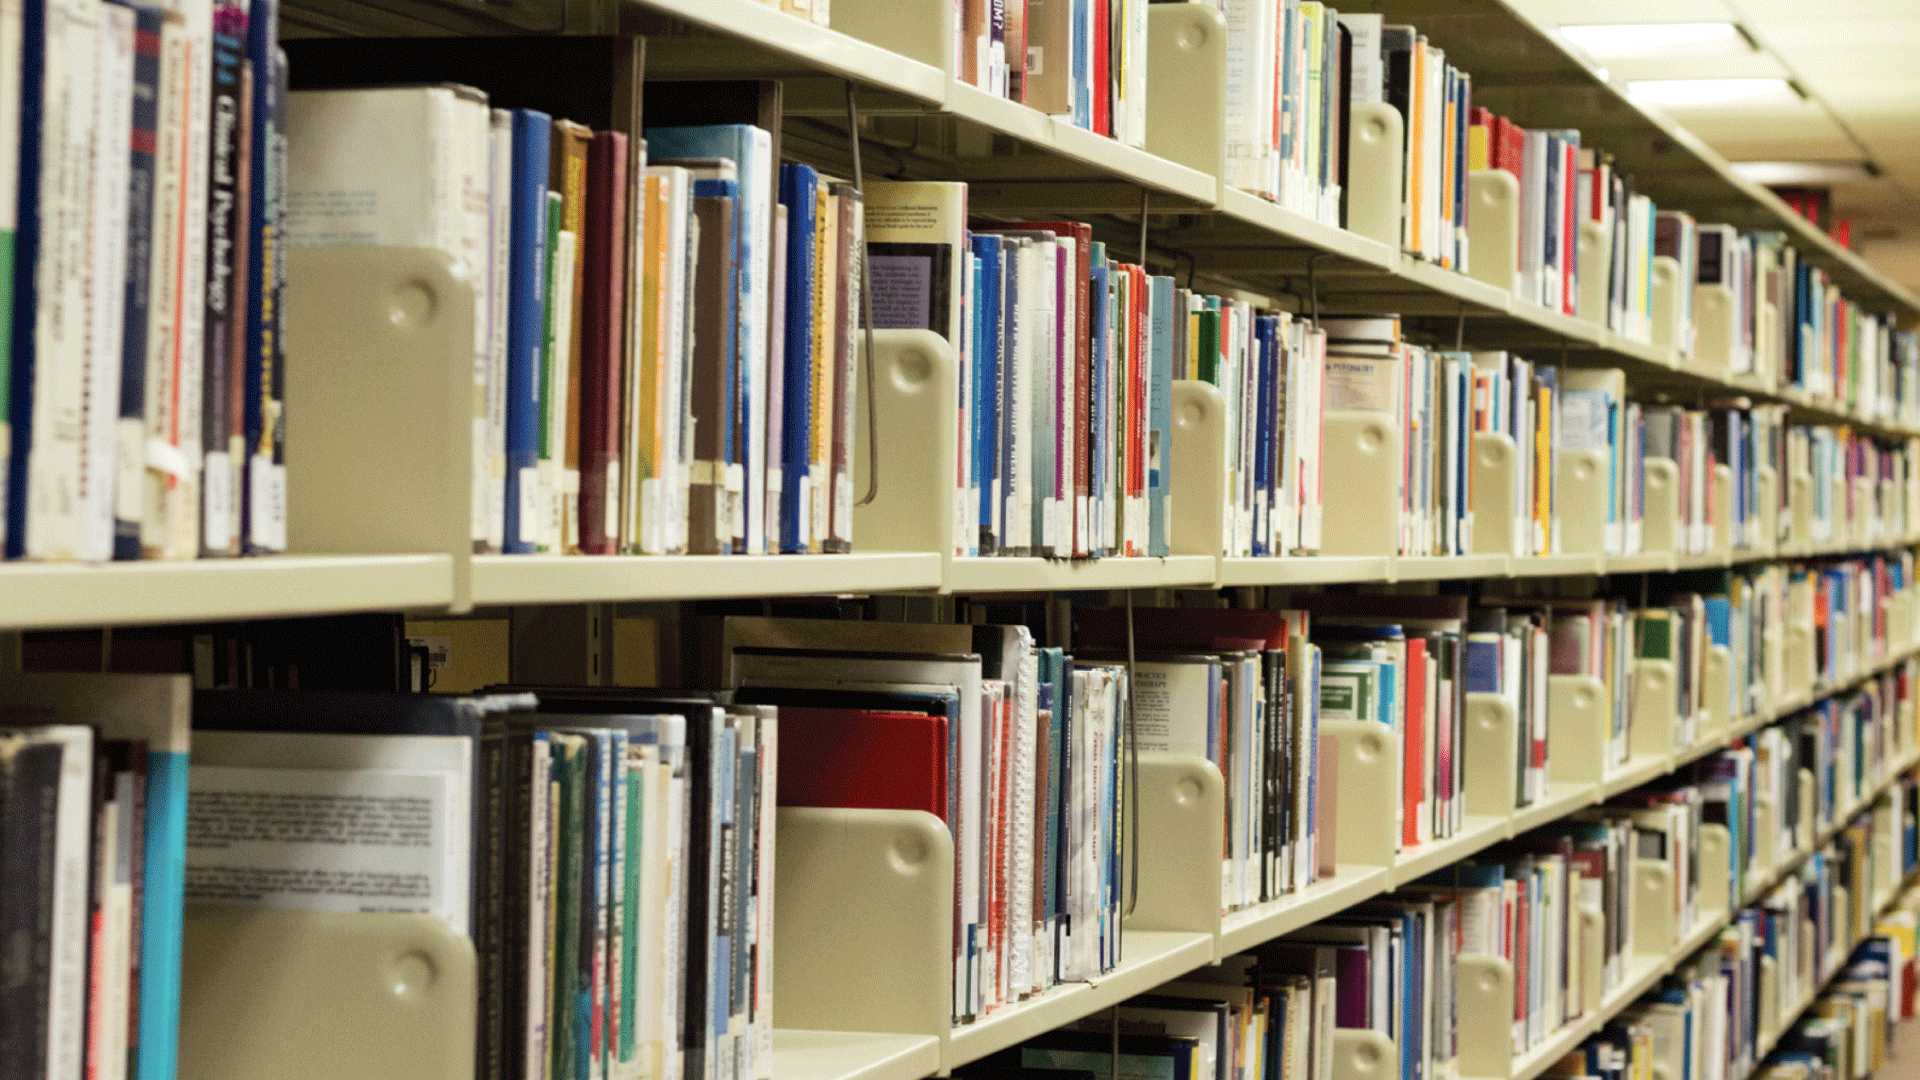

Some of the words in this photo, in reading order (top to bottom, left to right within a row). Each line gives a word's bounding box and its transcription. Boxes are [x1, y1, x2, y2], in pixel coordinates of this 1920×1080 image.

[213, 94, 235, 184] Clinical
[207, 188, 233, 313] Psychology
[722, 828, 732, 879] Bodily
[721, 884, 732, 931] Cures
